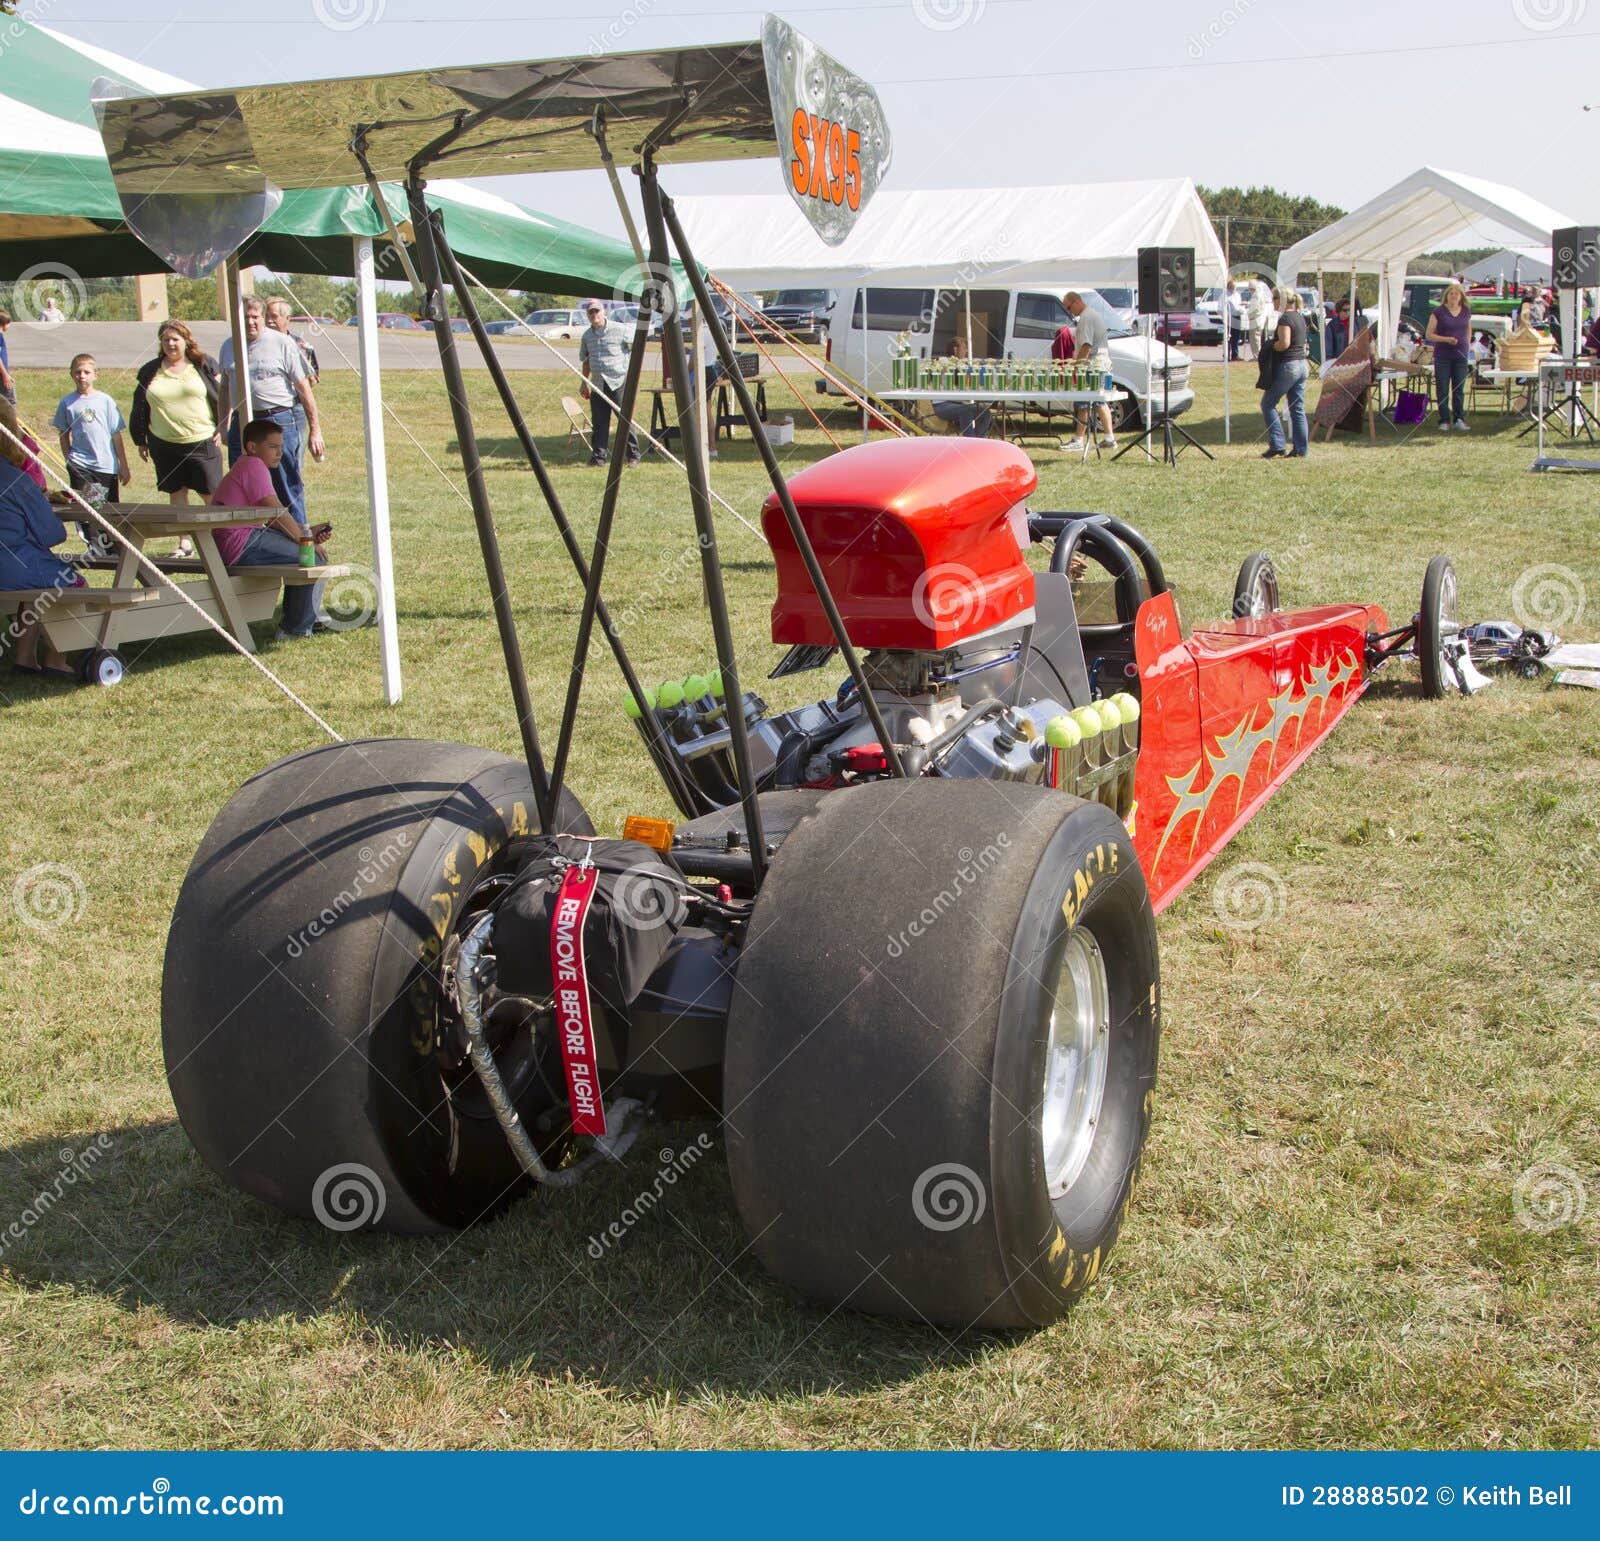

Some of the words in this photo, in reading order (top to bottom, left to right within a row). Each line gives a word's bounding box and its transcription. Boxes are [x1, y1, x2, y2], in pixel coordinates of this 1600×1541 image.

[791, 107, 862, 213] SX95
[556, 898, 581, 982] REMOVE
[560, 989, 586, 1056] BEFORE
[570, 1062, 596, 1118] FLIGHT
